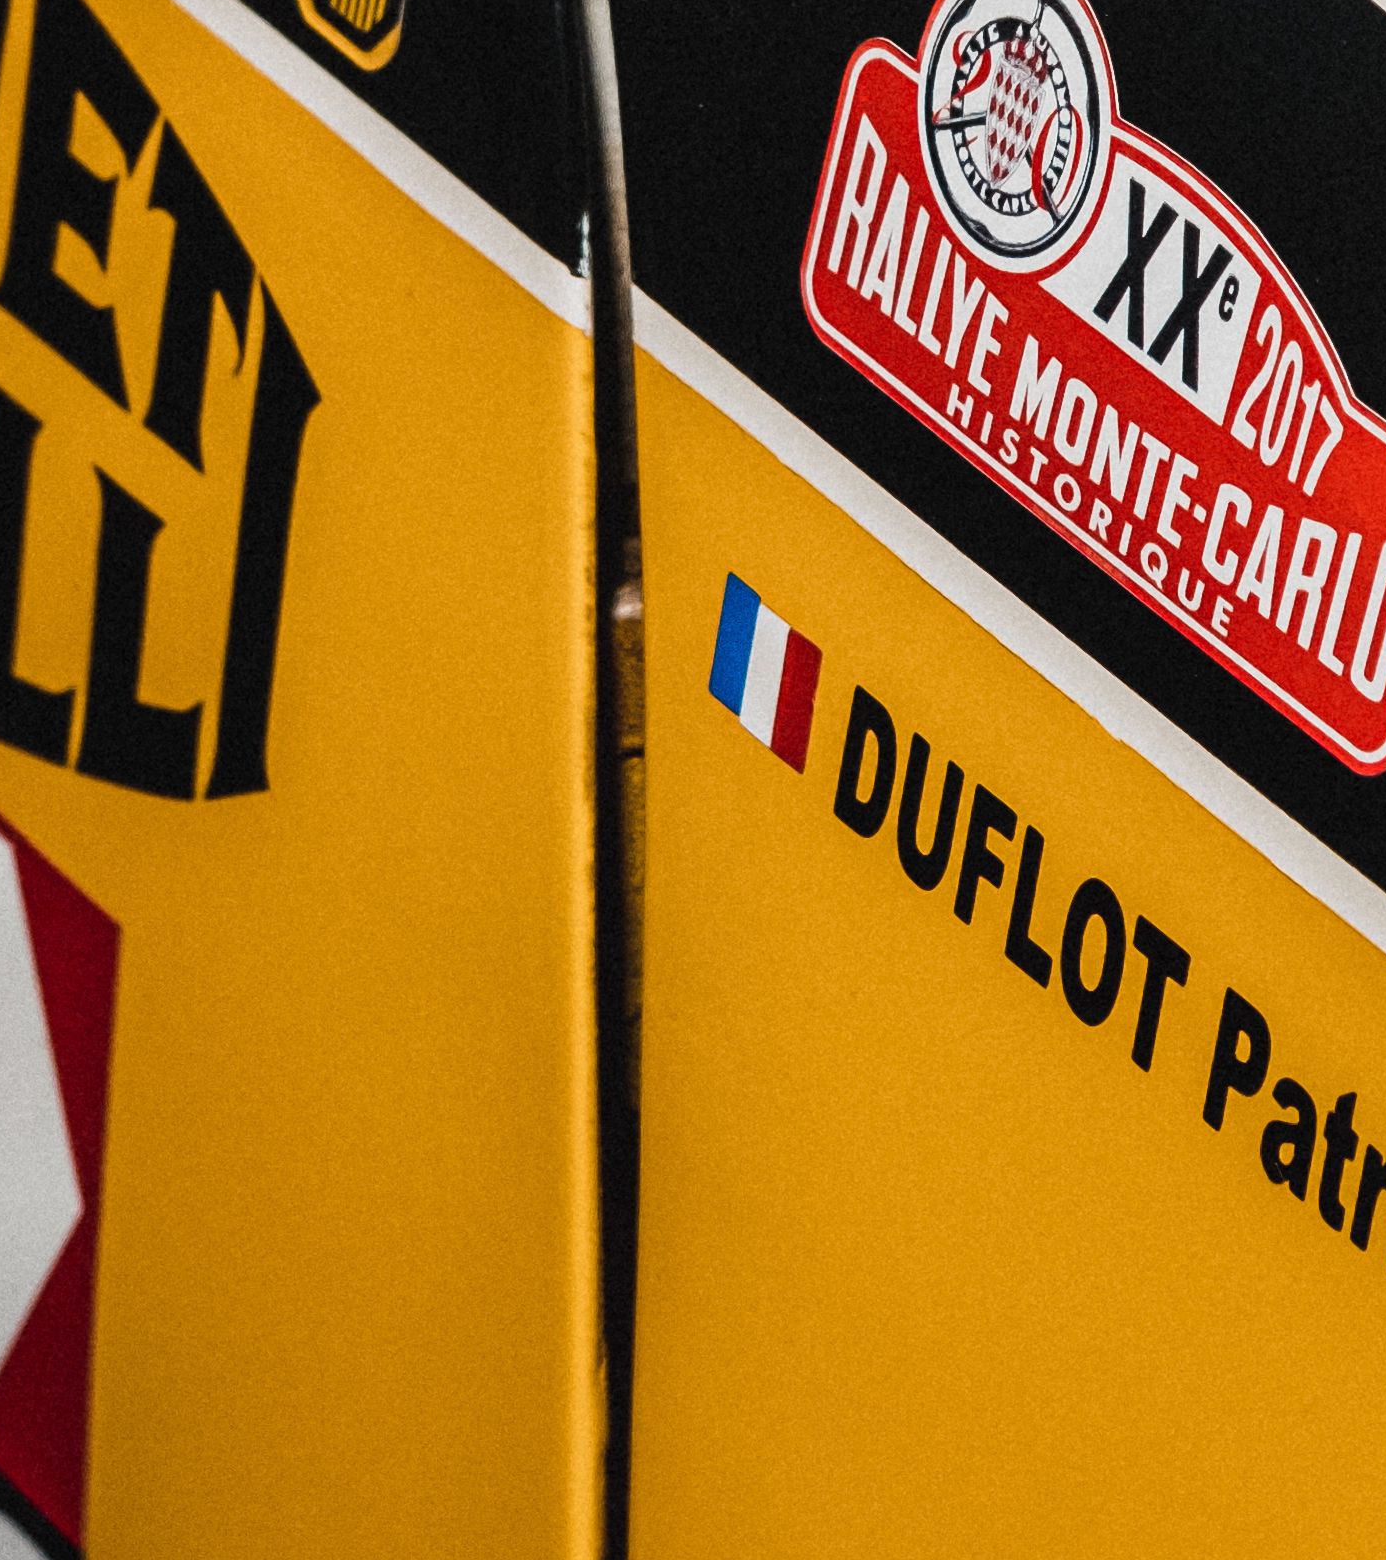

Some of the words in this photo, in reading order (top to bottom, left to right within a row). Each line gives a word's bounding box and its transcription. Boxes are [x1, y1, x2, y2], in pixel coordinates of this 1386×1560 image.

[827, 111, 1010, 396] RALLYE
[946, 381, 1234, 638] HISTORIQUE
[1231, 303, 1346, 496] 2017
[834, 683, 1193, 1074] DUFLOT
